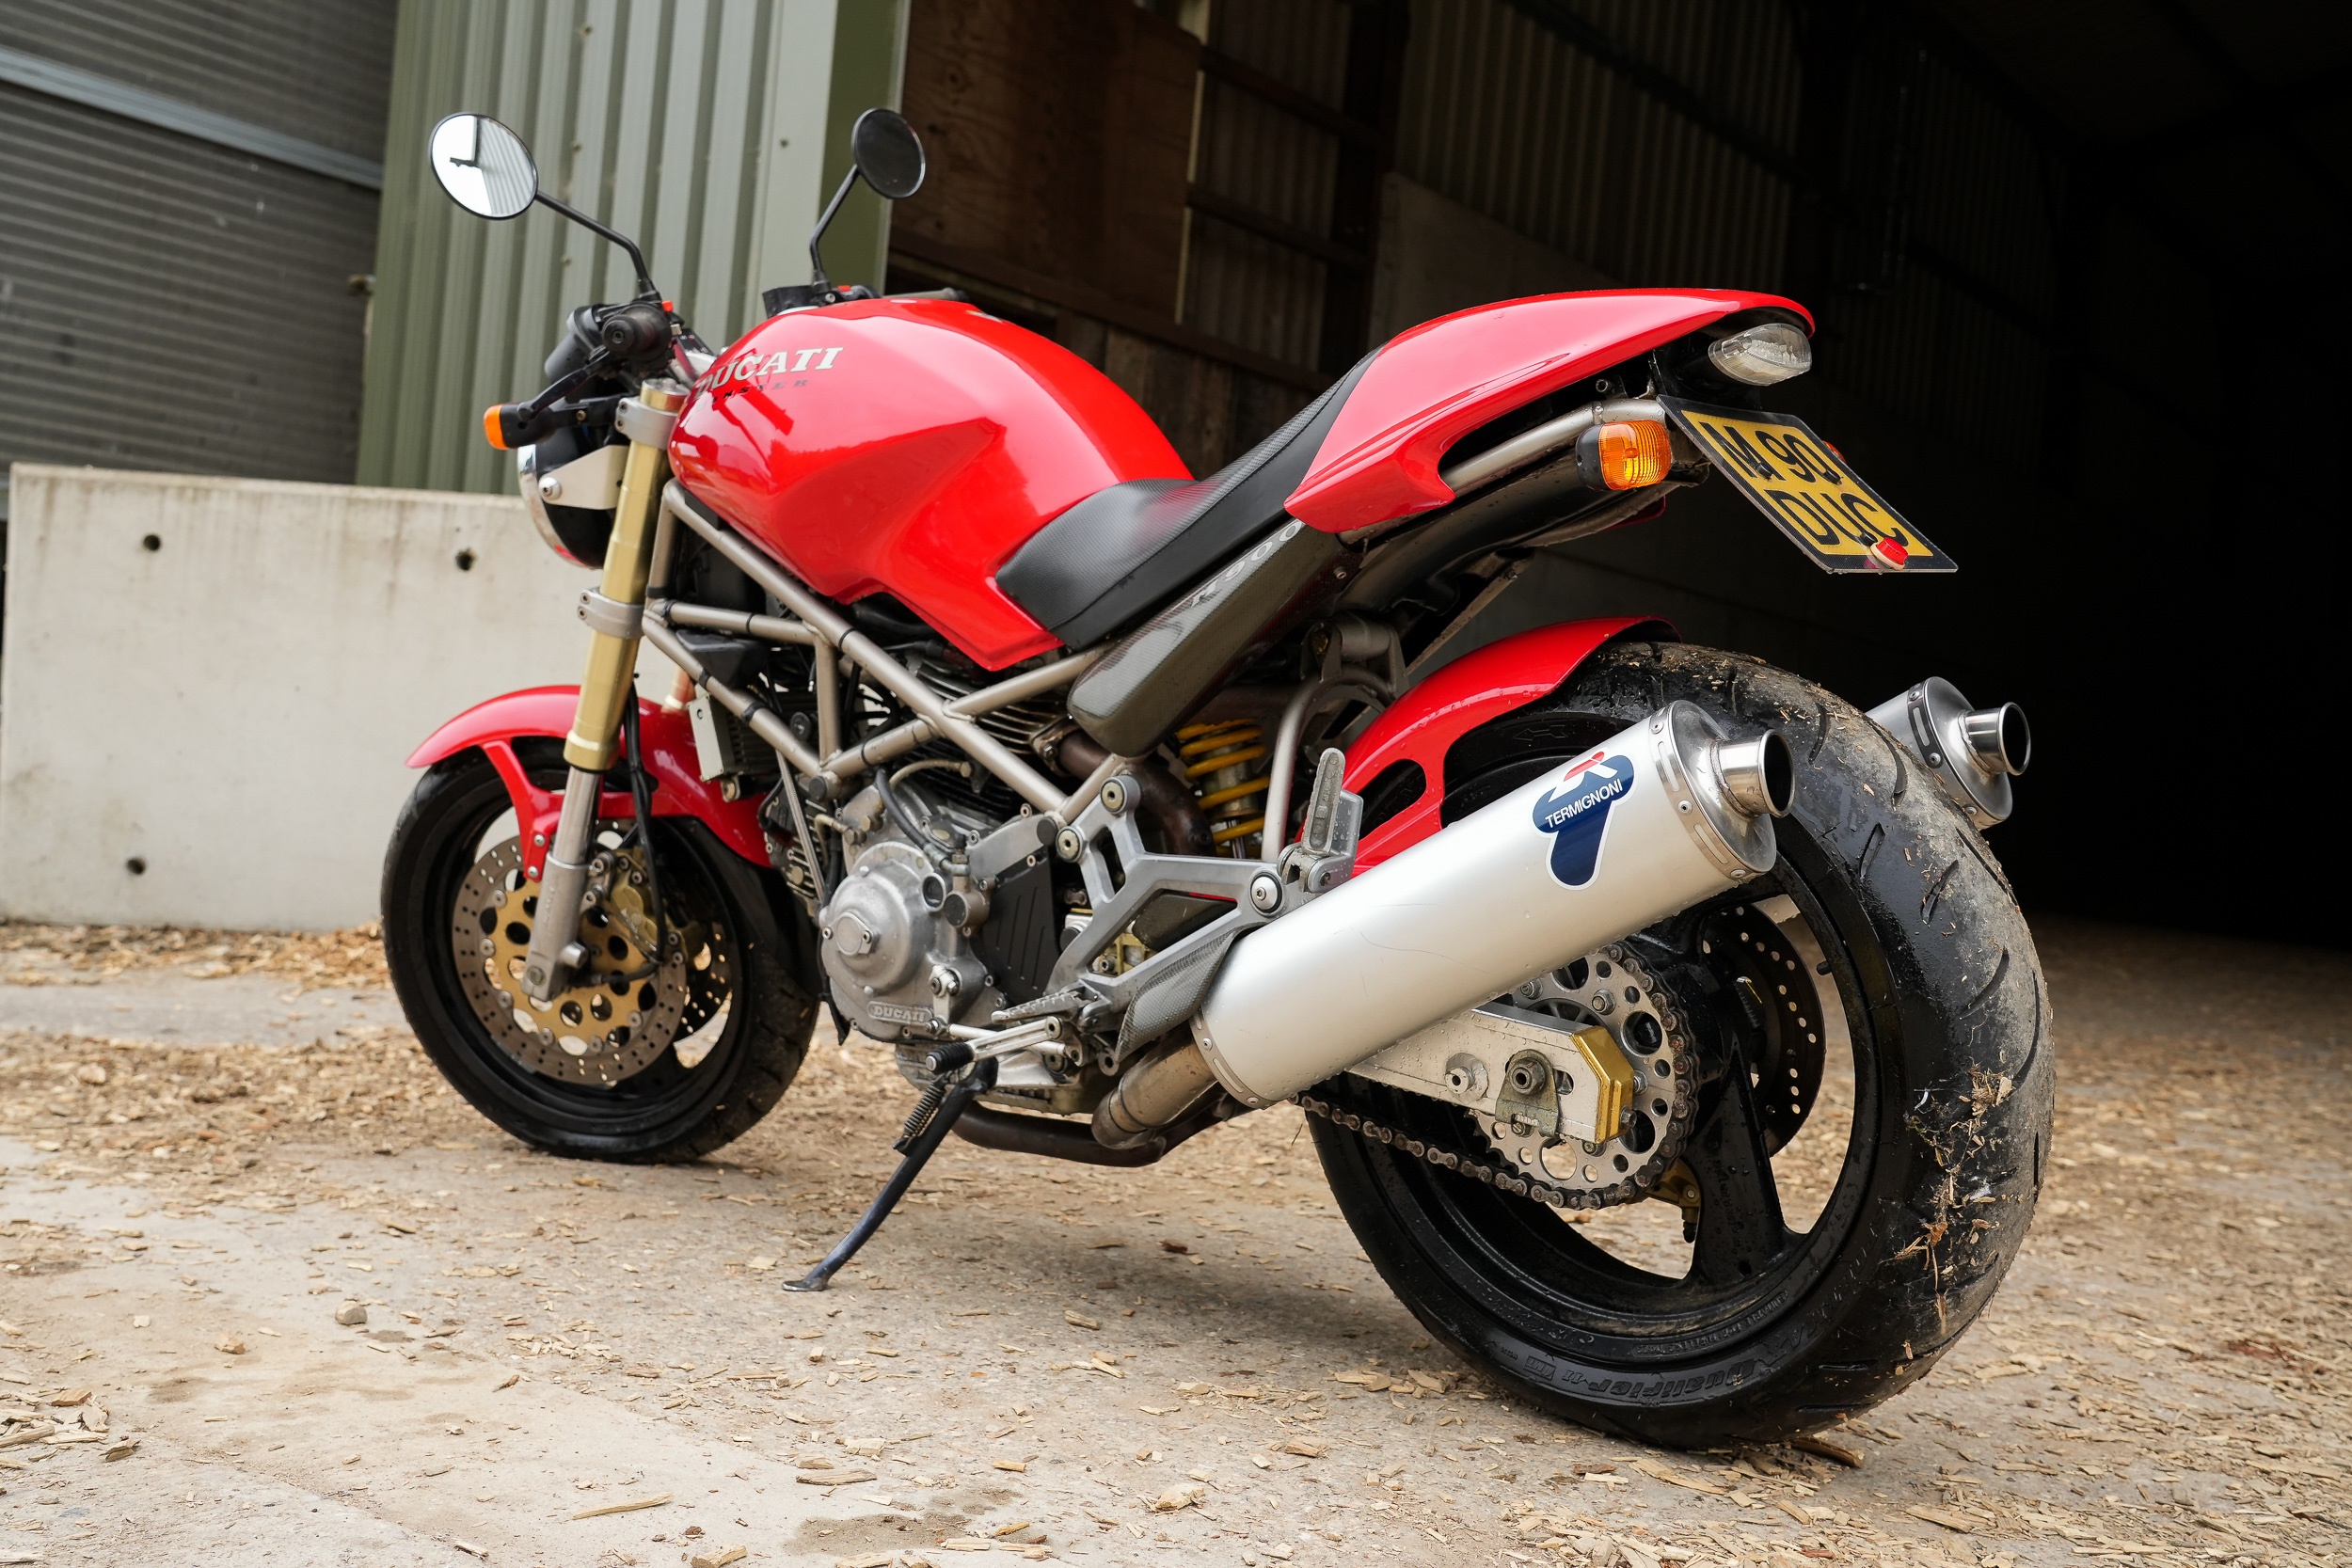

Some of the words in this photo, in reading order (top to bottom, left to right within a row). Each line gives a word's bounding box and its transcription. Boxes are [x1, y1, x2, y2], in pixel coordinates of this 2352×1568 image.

[694, 346, 844, 400] DUCATI
[1698, 421, 1842, 485] M90
[1765, 489, 1910, 546] DUC
[1544, 778, 1624, 829] TERMIGNONI
[873, 1005, 927, 1022] DUCATI
[1587, 1358, 1756, 1399] Qualifier
